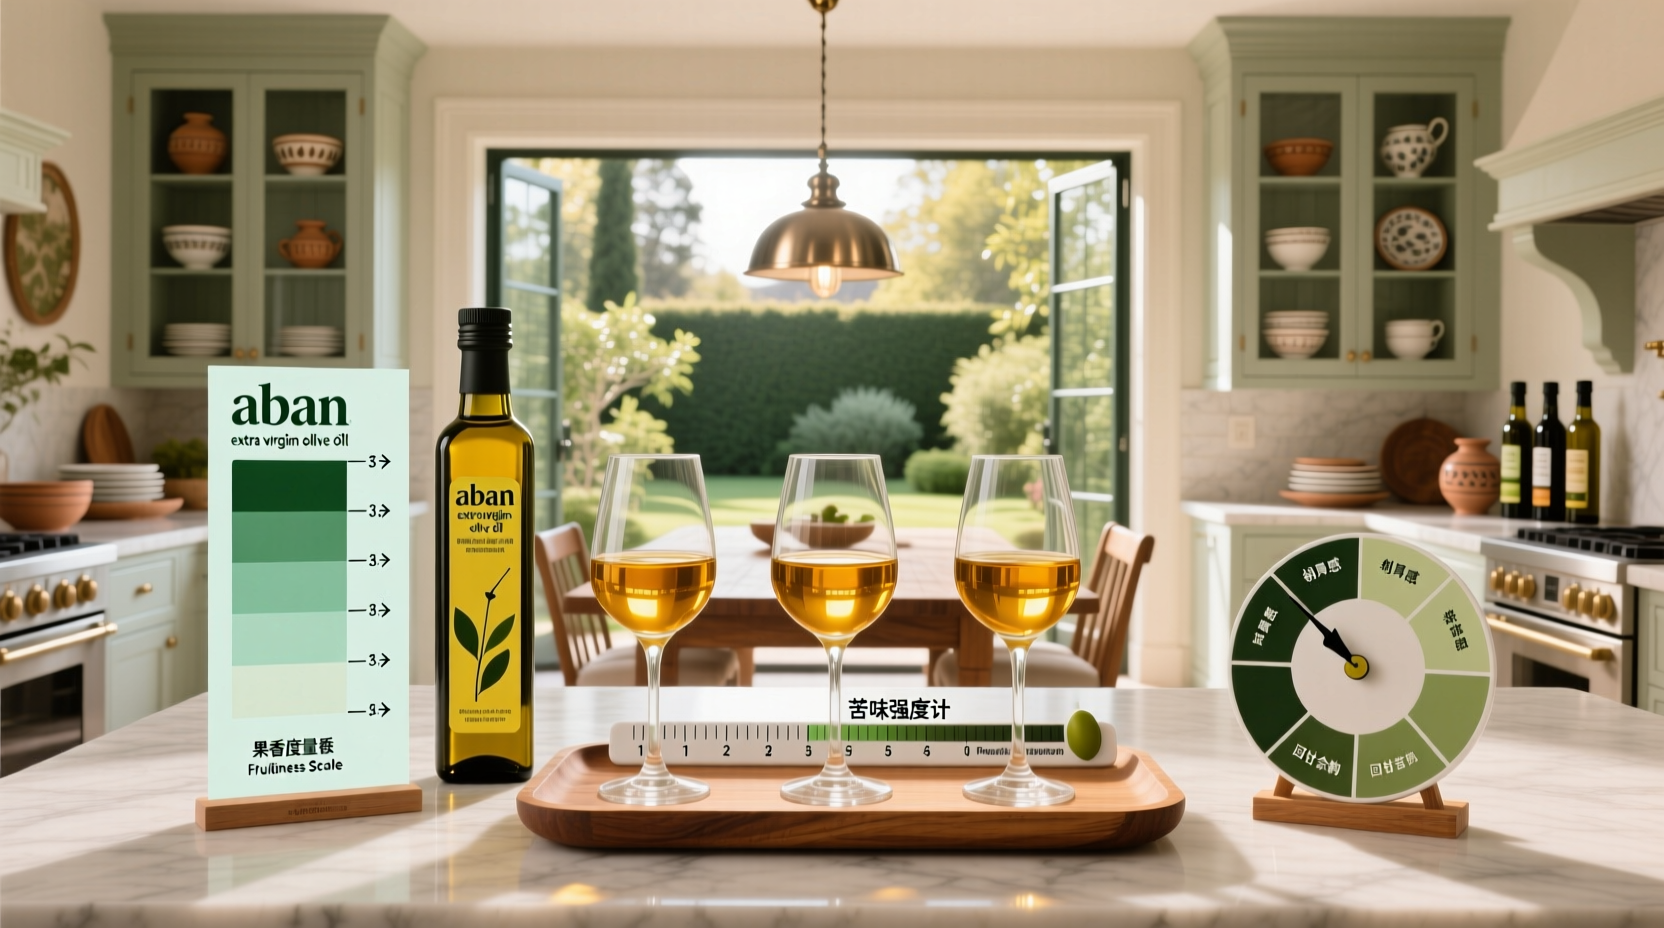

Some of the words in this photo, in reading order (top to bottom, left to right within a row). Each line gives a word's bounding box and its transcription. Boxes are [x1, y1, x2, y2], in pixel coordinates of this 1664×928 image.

[231, 382, 350, 426] aban
[231, 434, 260, 446] extra
[455, 483, 515, 506] aban
[848, 697, 951, 720] 苦味强度计
[682, 744, 689, 757] 1
[722, 744, 731, 757] 2
[764, 744, 773, 757] 2
[884, 744, 892, 757] 5
